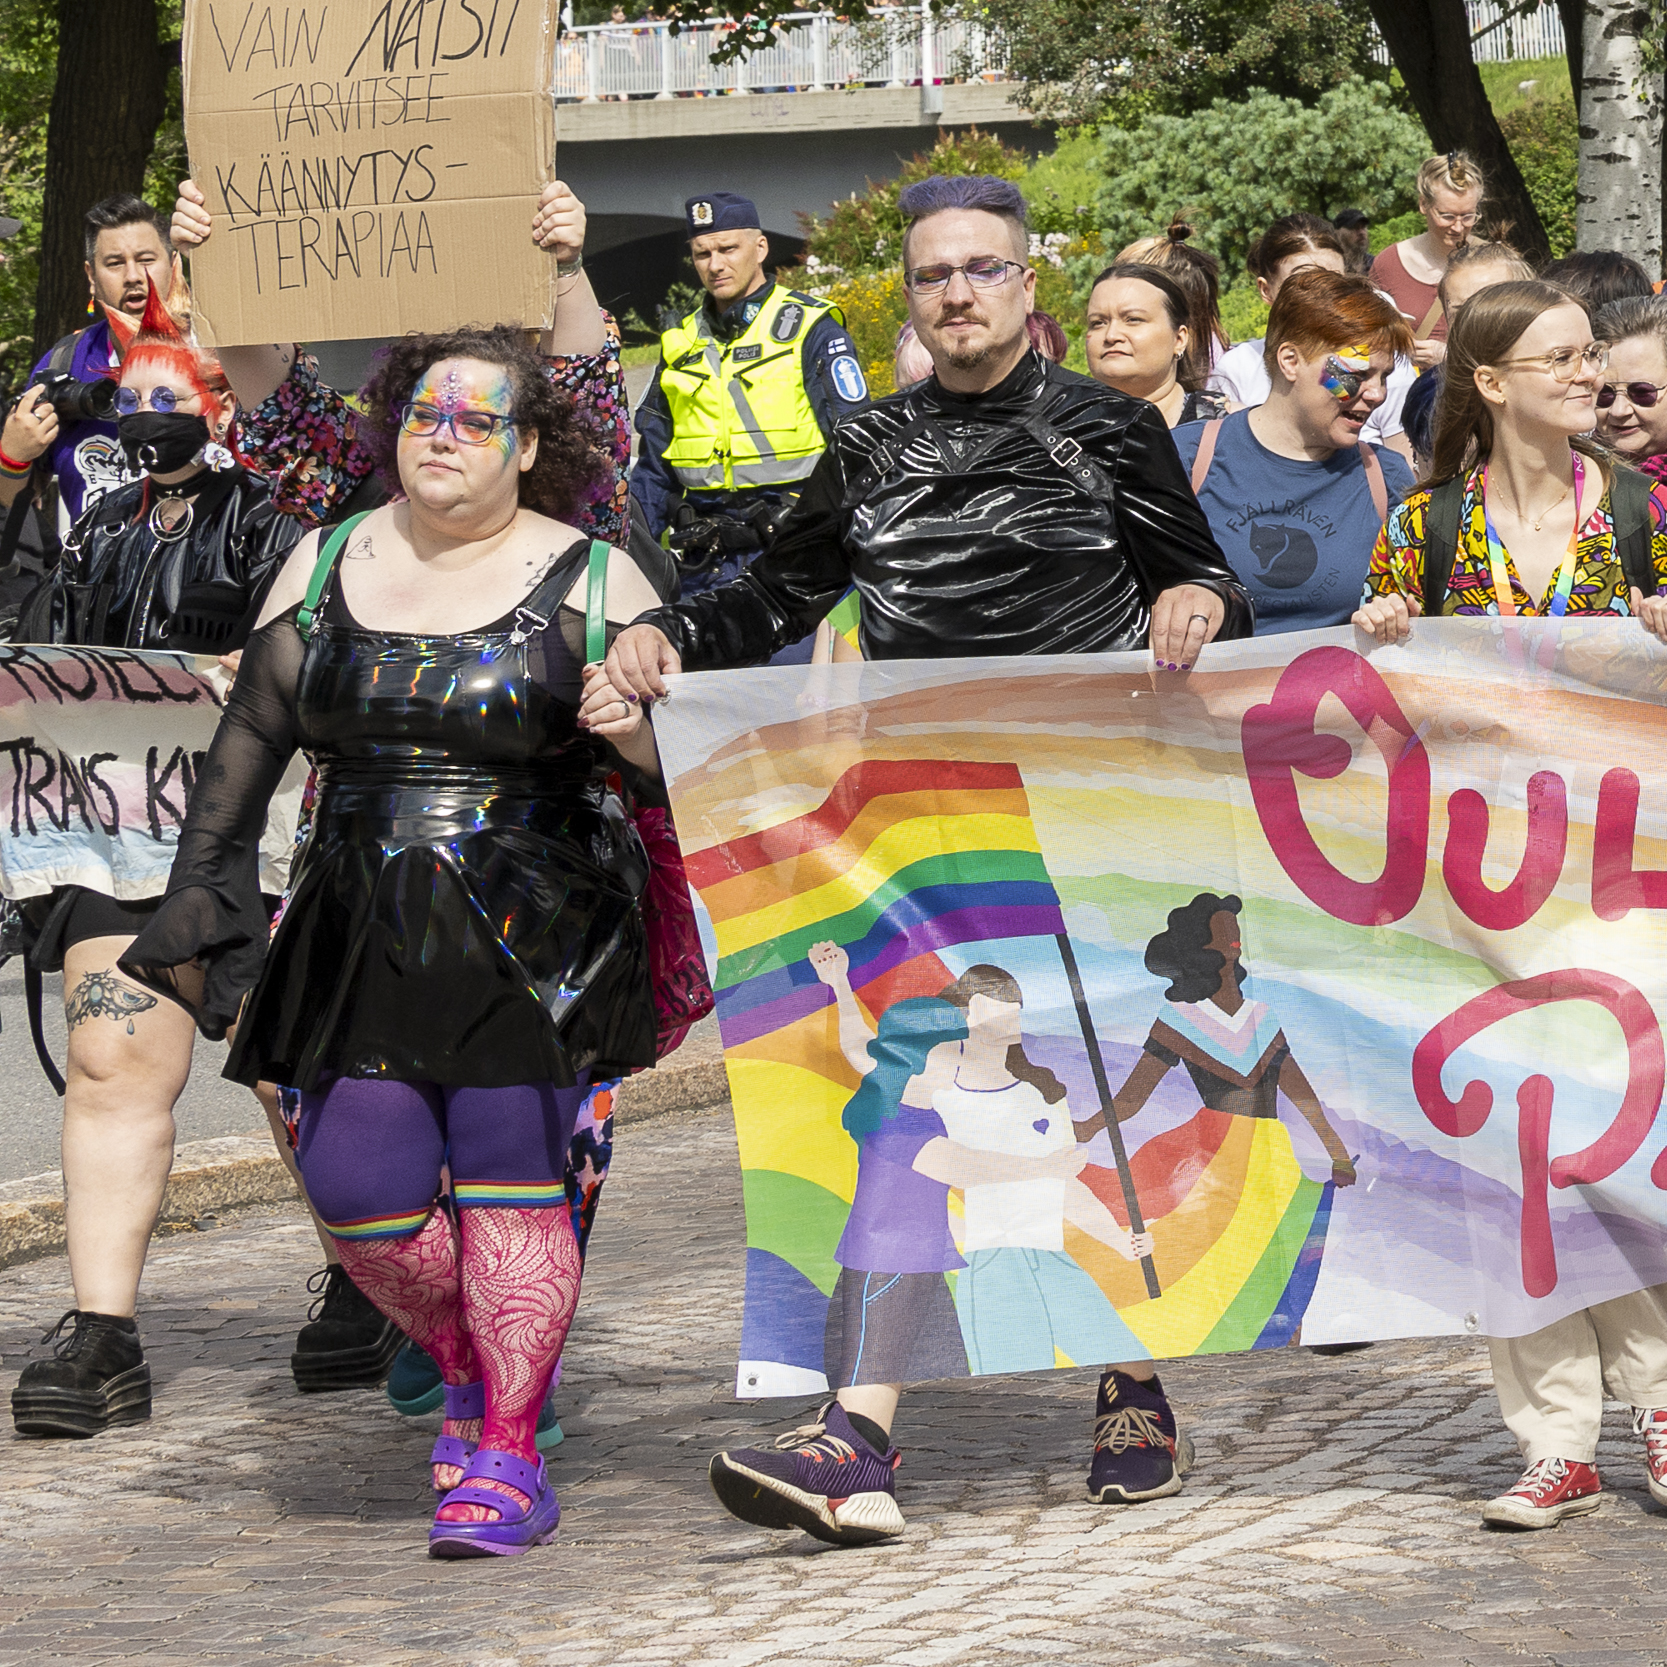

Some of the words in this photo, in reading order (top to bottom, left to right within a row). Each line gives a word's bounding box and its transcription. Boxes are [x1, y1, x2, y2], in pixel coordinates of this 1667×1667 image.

[208, 1, 328, 73] VAIN
[252, 72, 452, 142] TARVITSEE
[215, 144, 468, 223] KÄÄNNYTYS-
[228, 210, 438, 295] TERAPIAA
[736, 346, 759, 355] POLIISI
[1226, 499, 1337, 538] FJÄLLRÄVEN
